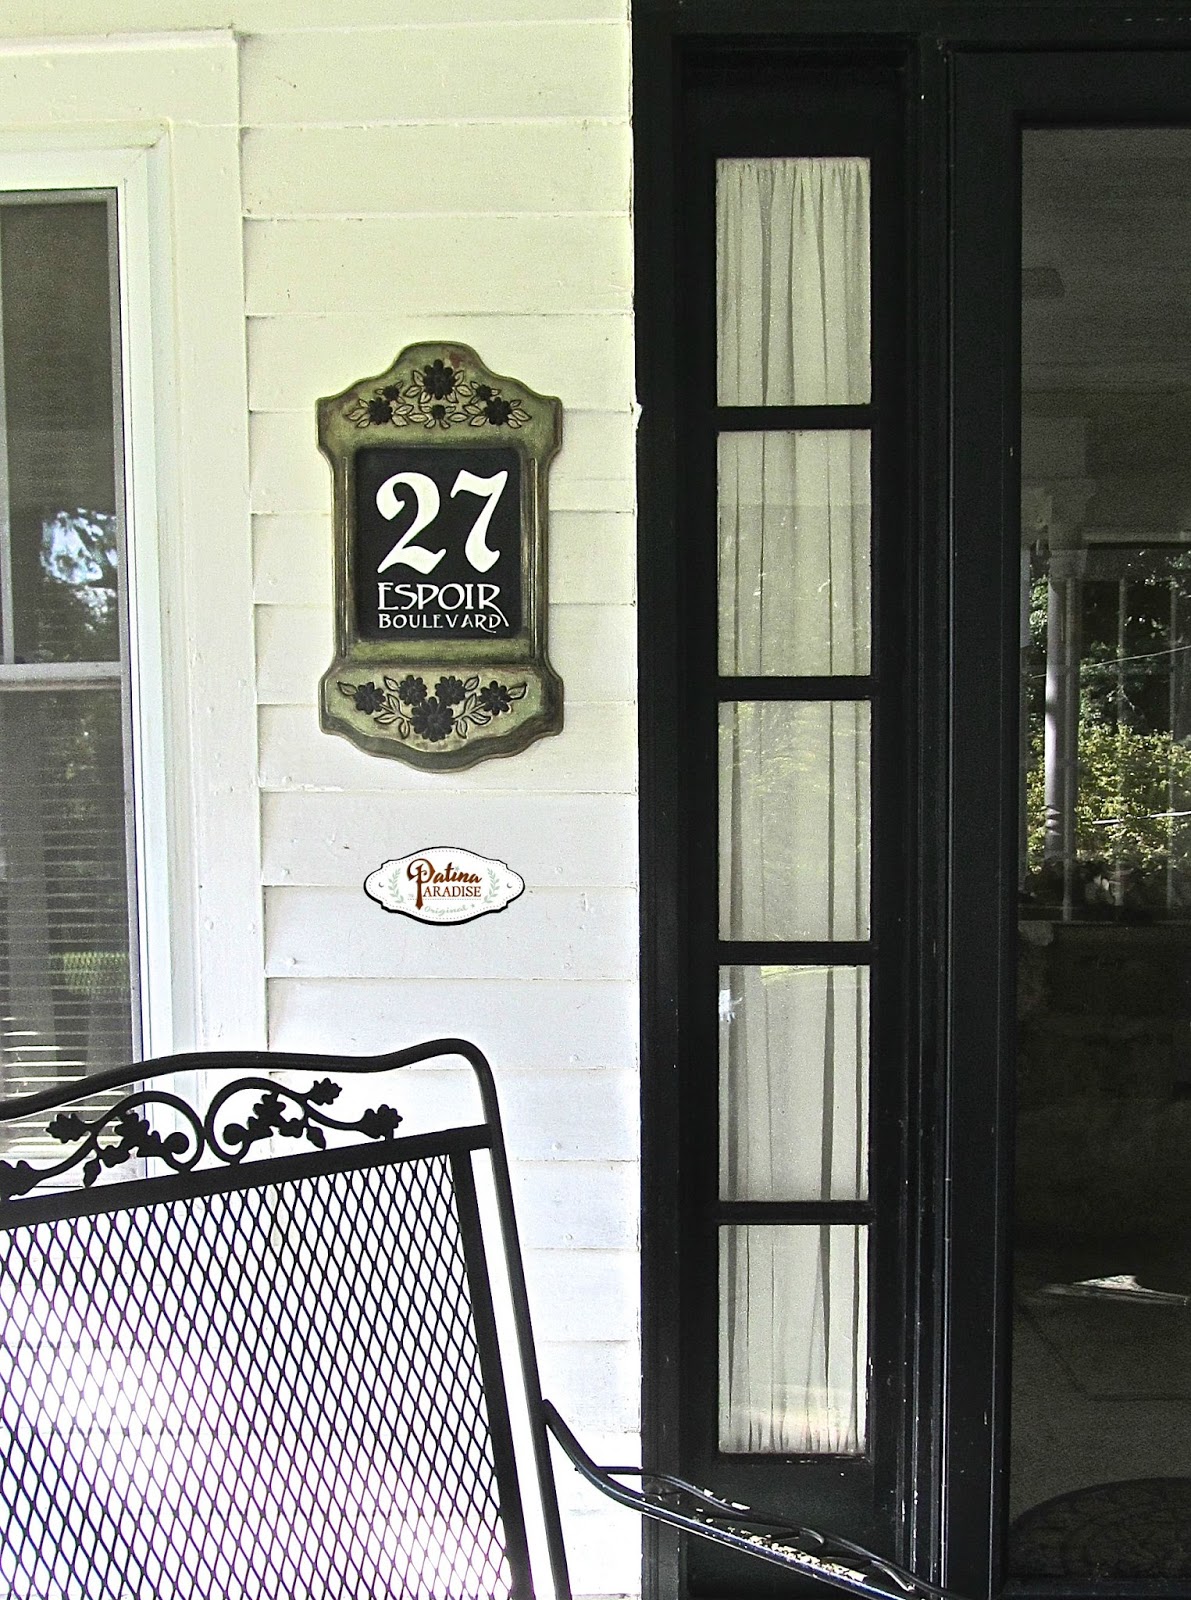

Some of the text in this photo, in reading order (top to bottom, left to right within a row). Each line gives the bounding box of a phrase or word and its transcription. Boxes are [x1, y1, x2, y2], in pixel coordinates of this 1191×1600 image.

[376, 469, 508, 575] 27
[377, 582, 509, 627] ESPOIR
[378, 613, 501, 633] BOULEVARD
